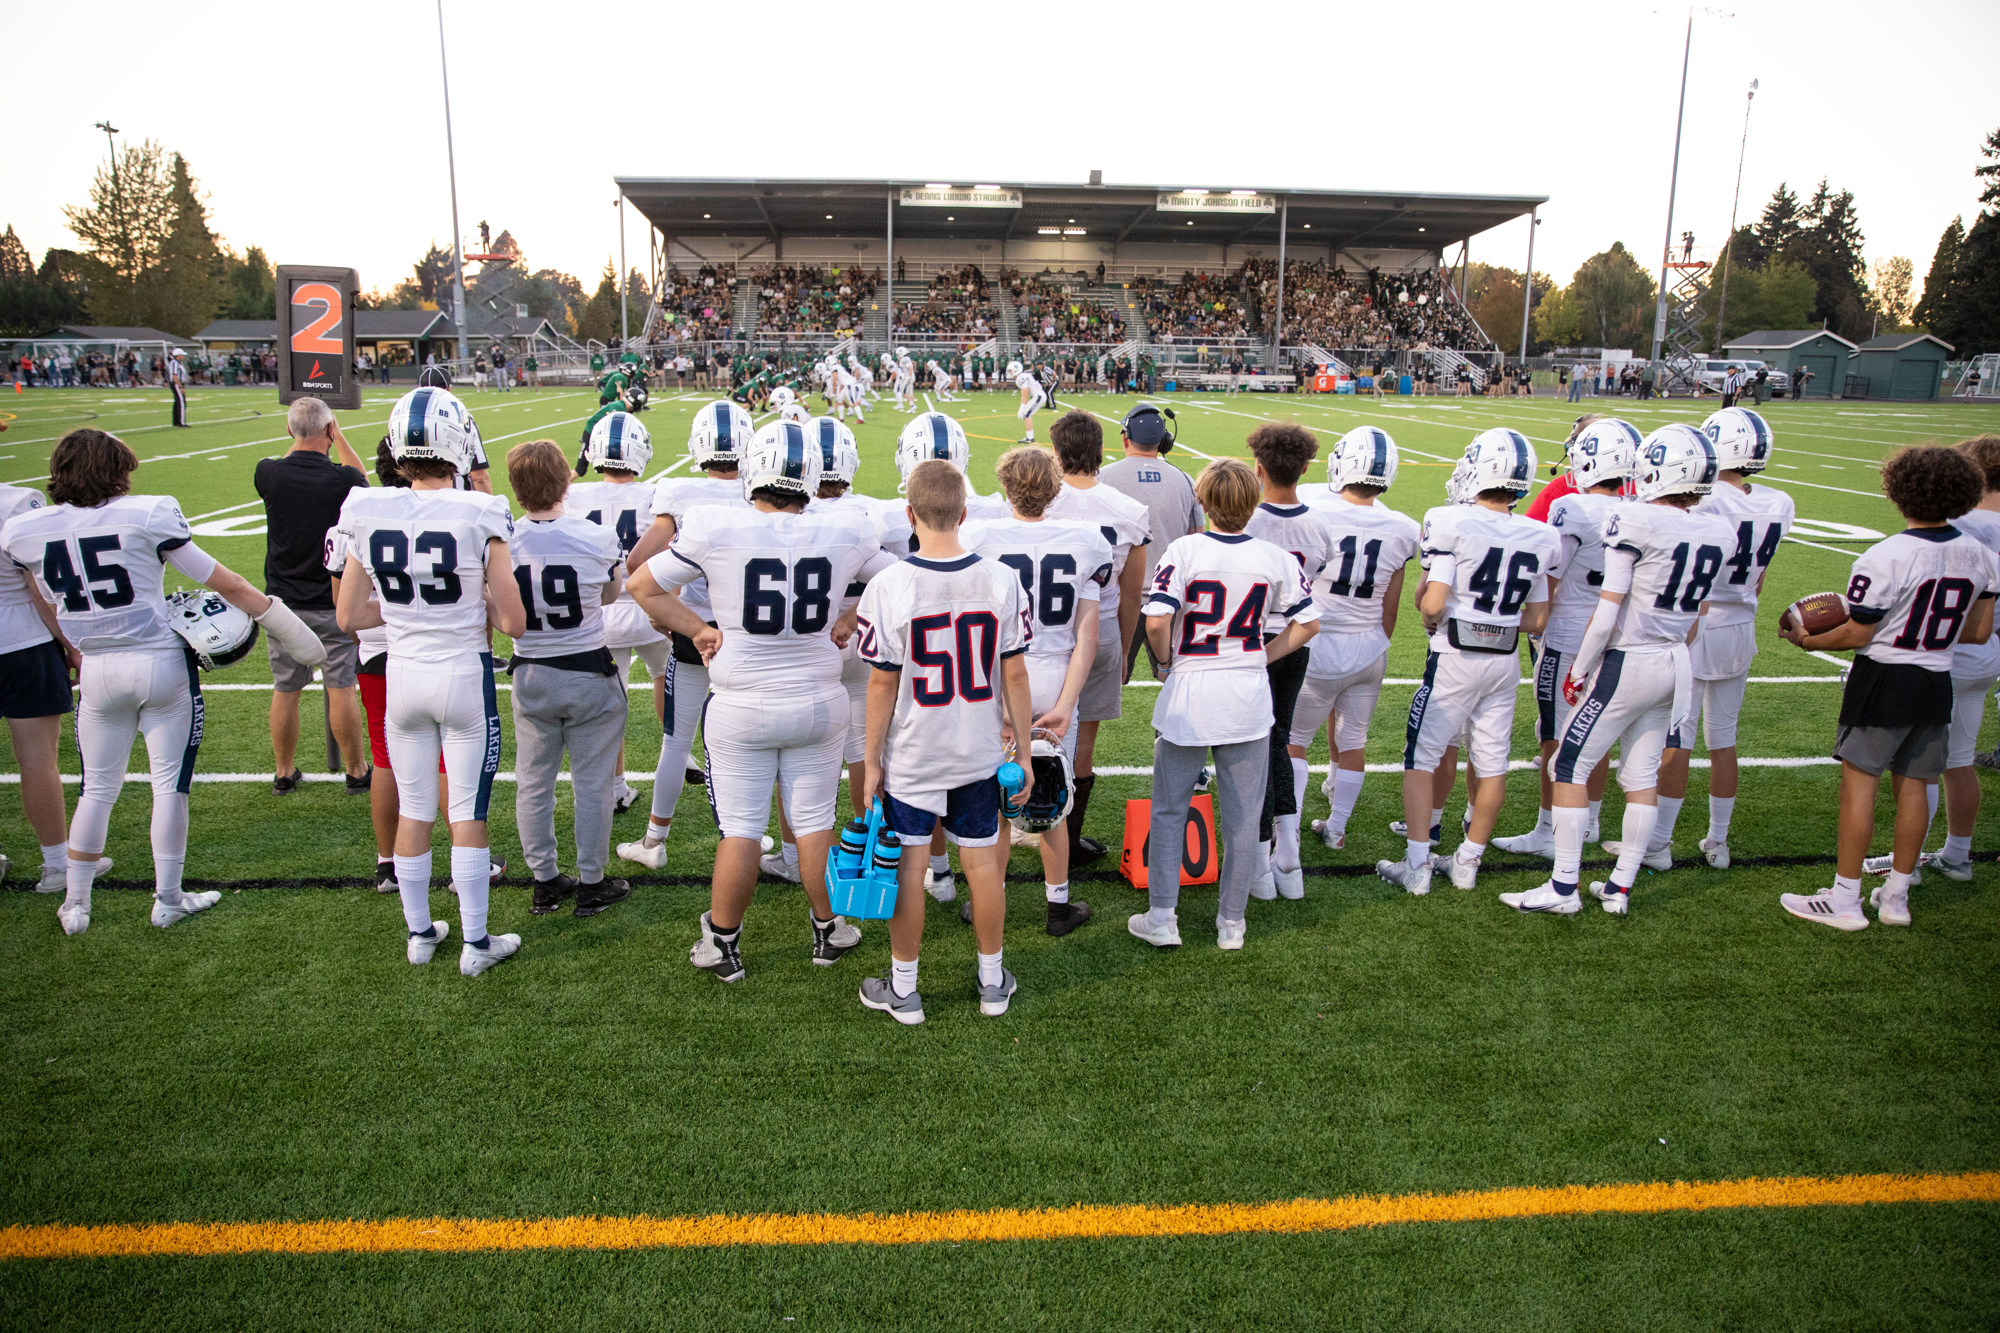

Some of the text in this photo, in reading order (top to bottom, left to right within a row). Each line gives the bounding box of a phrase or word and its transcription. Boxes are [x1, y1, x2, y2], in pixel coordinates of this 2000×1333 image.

[915, 192, 1007, 202] DENNIS LUDWIG STADIUM
[1171, 197, 1262, 208] MARTY JOHNSON FIELD
[291, 282, 344, 355] 2
[405, 447, 434, 456] schutt
[819, 471, 840, 479] chutt
[1137, 470, 1162, 483] LED
[1685, 449, 1694, 457] 18
[774, 478, 803, 490] schutt
[1505, 481, 1528, 489] schutt
[43, 533, 136, 613] 45
[369, 529, 463, 606] 83
[1329, 535, 1383, 599] 11
[1652, 541, 1724, 613] 18
[1725, 520, 1782, 585] 44
[513, 564, 584, 631] 19
[742, 556, 833, 636] 68
[1468, 546, 1540, 616] 46
[1804, 600, 1835, 611] Wilson
[1847, 573, 1872, 604] 8
[1019, 606, 1034, 643] 5
[1178, 579, 1269, 656] 24
[1892, 577, 1975, 651] 18
[664, 650, 678, 697] LAKER
[910, 610, 998, 708] 50
[1538, 655, 1557, 702] LAKERS
[189, 693, 205, 747] LAKERS
[1408, 685, 1430, 731] LAKERS
[1566, 697, 1603, 747] LAKERS
[484, 714, 500, 773] LAKERS
